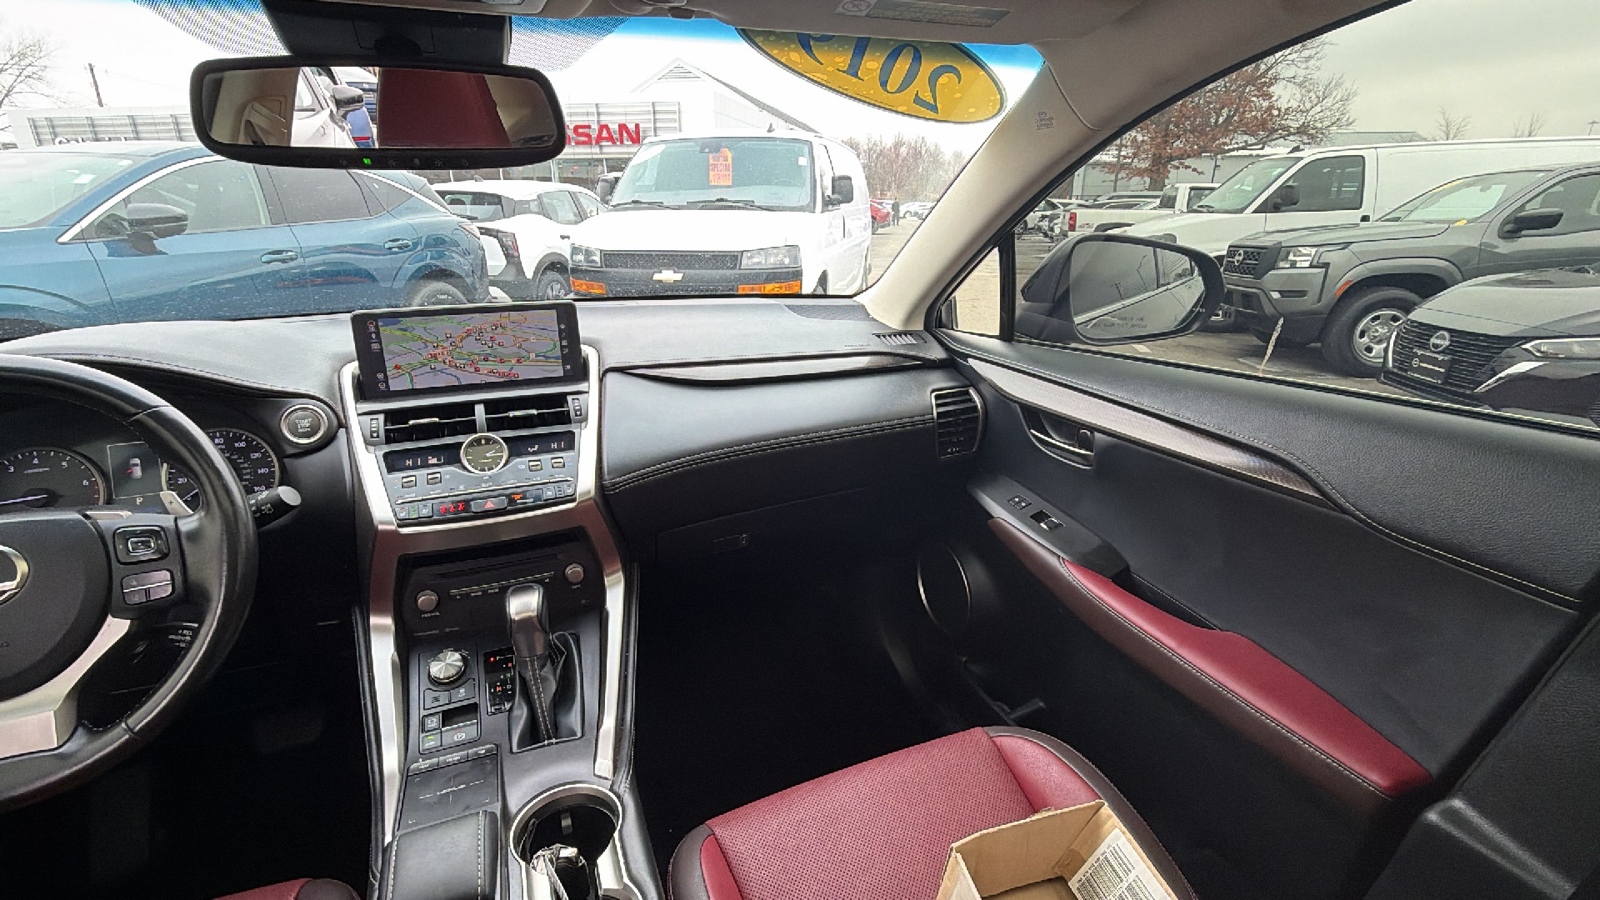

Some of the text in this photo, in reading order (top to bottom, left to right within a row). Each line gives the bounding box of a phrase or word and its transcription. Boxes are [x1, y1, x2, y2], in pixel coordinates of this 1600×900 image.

[7, 465, 15, 473] 3
[61, 461, 68, 469] 5
[136, 496, 144, 506] P
